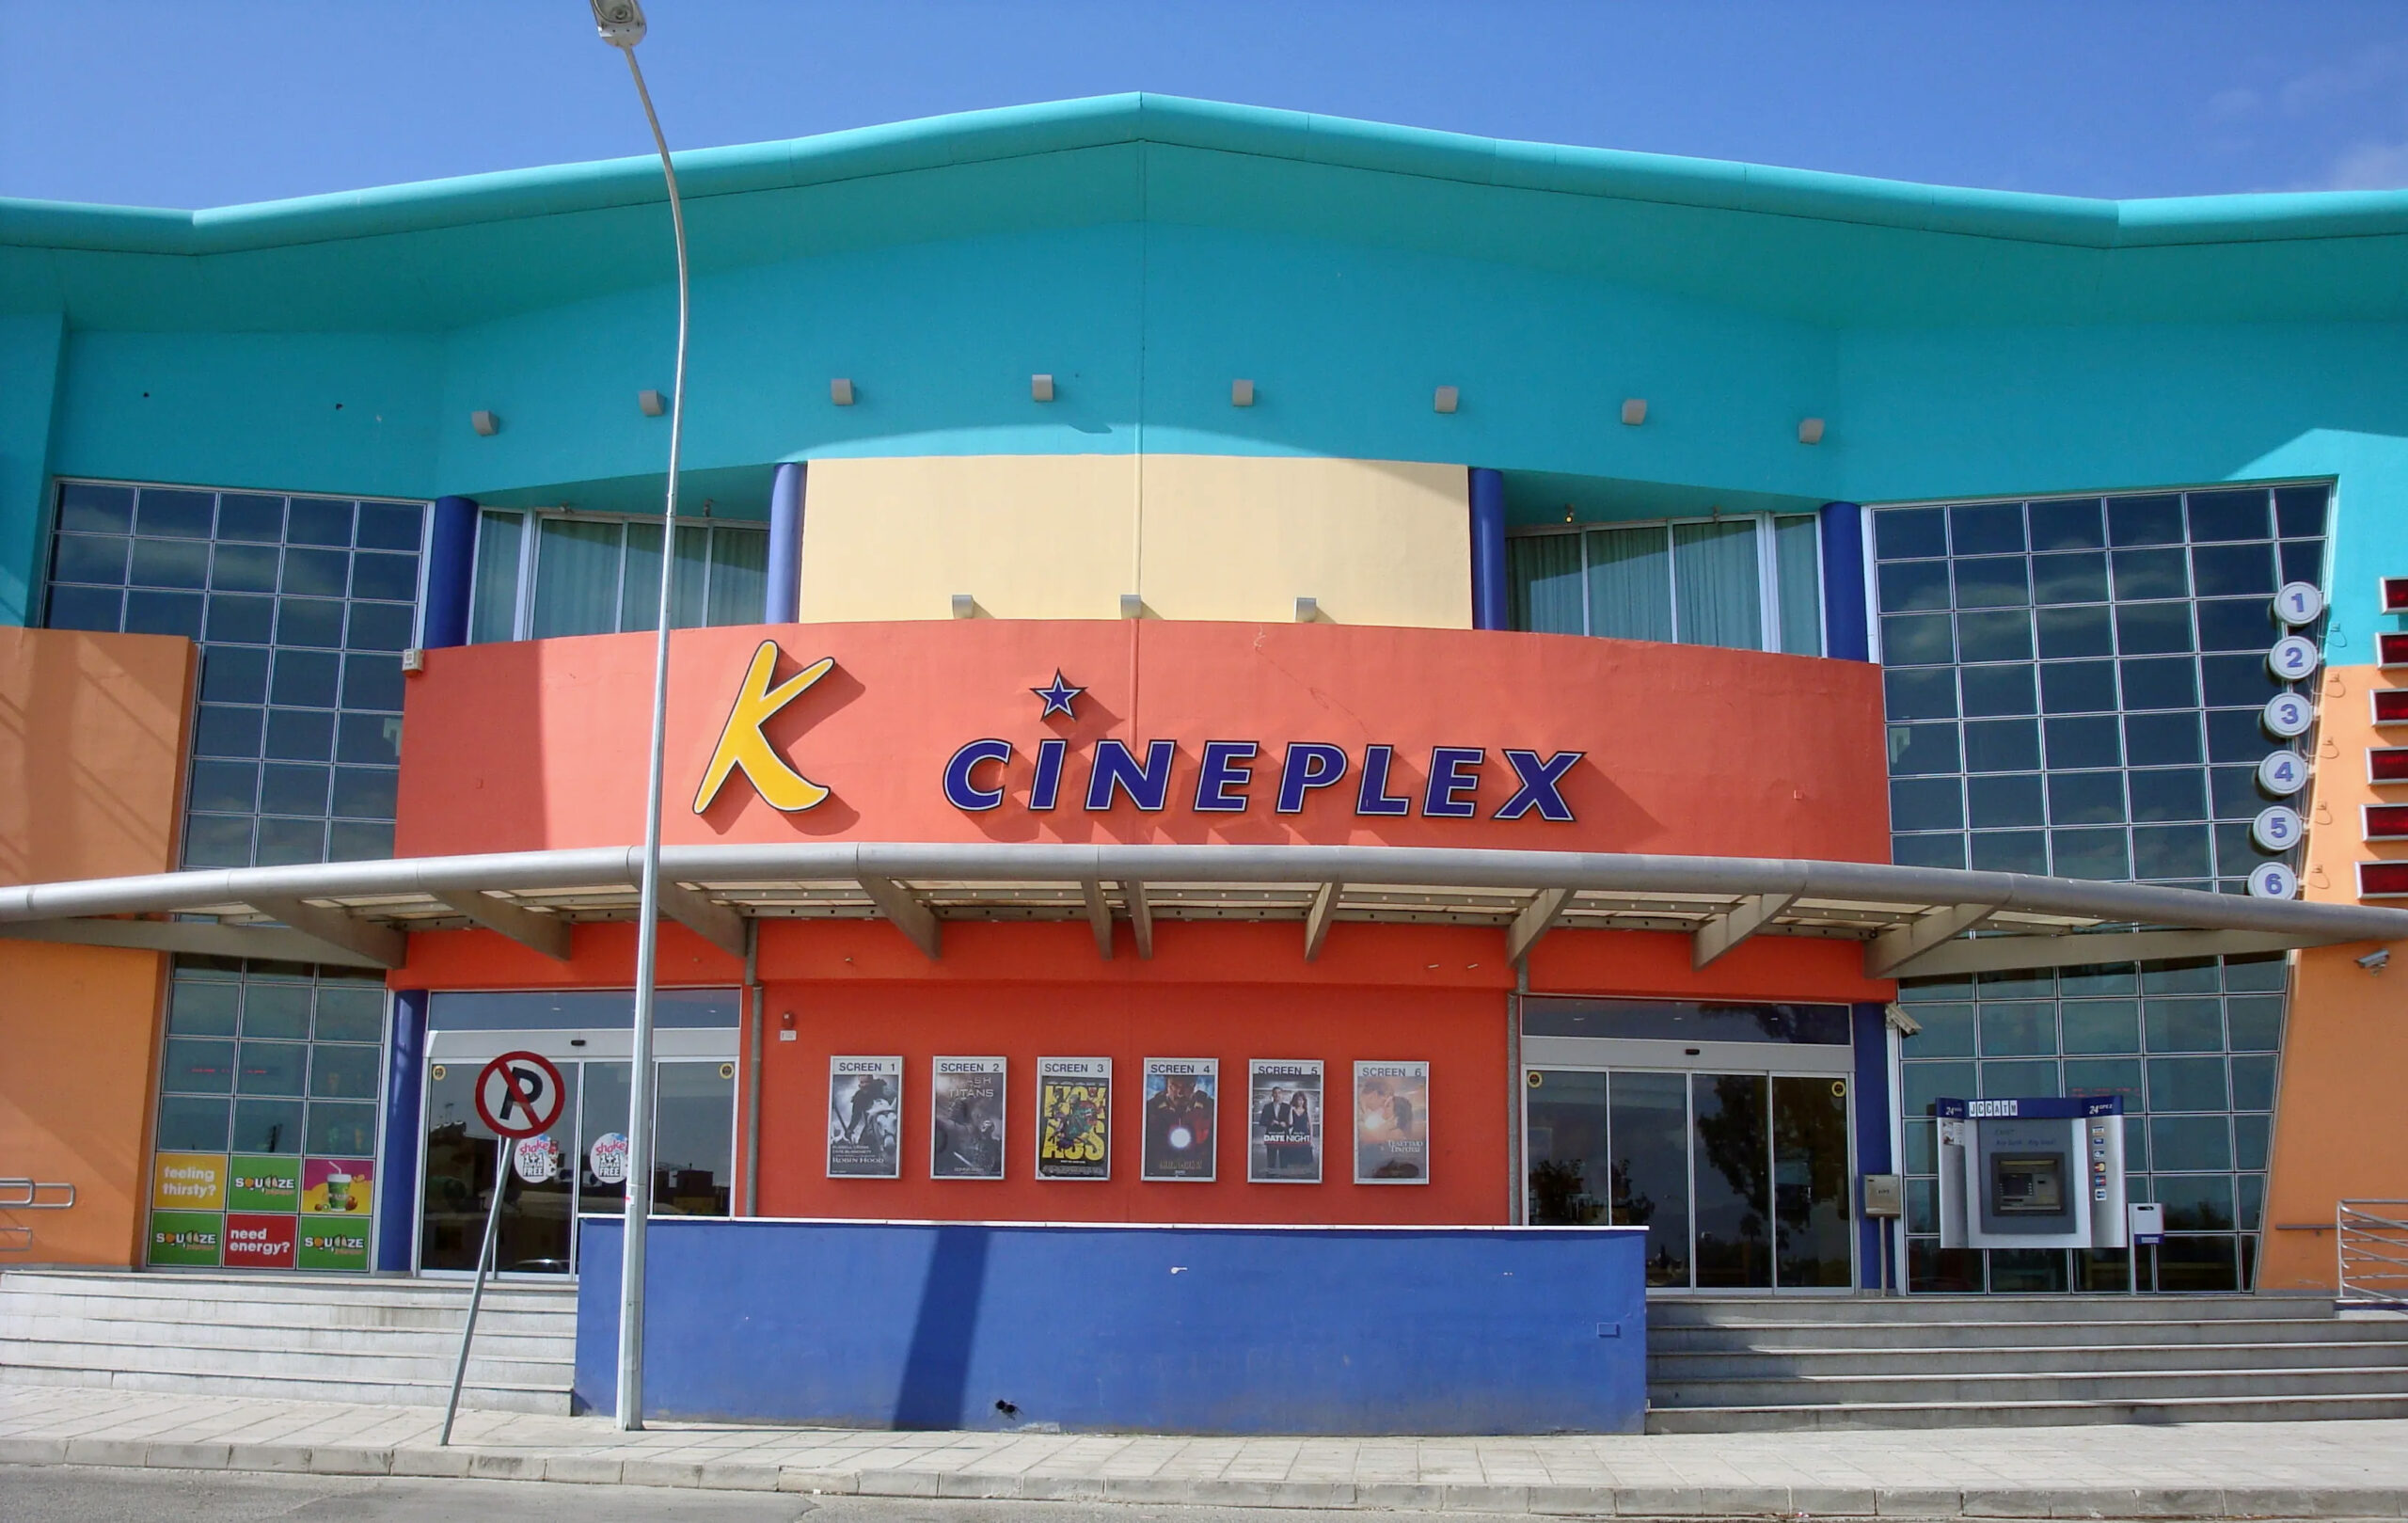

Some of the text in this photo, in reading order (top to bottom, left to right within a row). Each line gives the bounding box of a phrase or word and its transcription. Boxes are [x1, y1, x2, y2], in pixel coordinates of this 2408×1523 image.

[2290, 593, 2304, 612] 1
[2286, 647, 2303, 668] 2
[2281, 704, 2299, 724] 3
[692, 639, 1588, 822] K CINEPLEX
[2274, 762, 2294, 782] 4
[2271, 817, 2288, 838] 5
[2265, 874, 2283, 895] 6
[839, 1062, 895, 1071] SCREEN 1
[941, 1063, 999, 1071] SCREEN 2
[1044, 1063, 1103, 1072] SCREEN 3
[1150, 1064, 1210, 1073] SCREEN 4
[1258, 1066, 1302, 1074] SCREEN
[1362, 1068, 1421, 1076] SCREEN 6
[499, 1066, 544, 1120] P
[949, 1088, 994, 1099] TITANS
[519, 1139, 549, 1156] shake
[594, 1139, 626, 1156] shake
[164, 1166, 214, 1182] feeling
[523, 1167, 544, 1176] FREE
[599, 1167, 621, 1177] FREE
[163, 1183, 216, 1199] thirsty?
[230, 1229, 267, 1240] need
[230, 1241, 291, 1255] energy?
